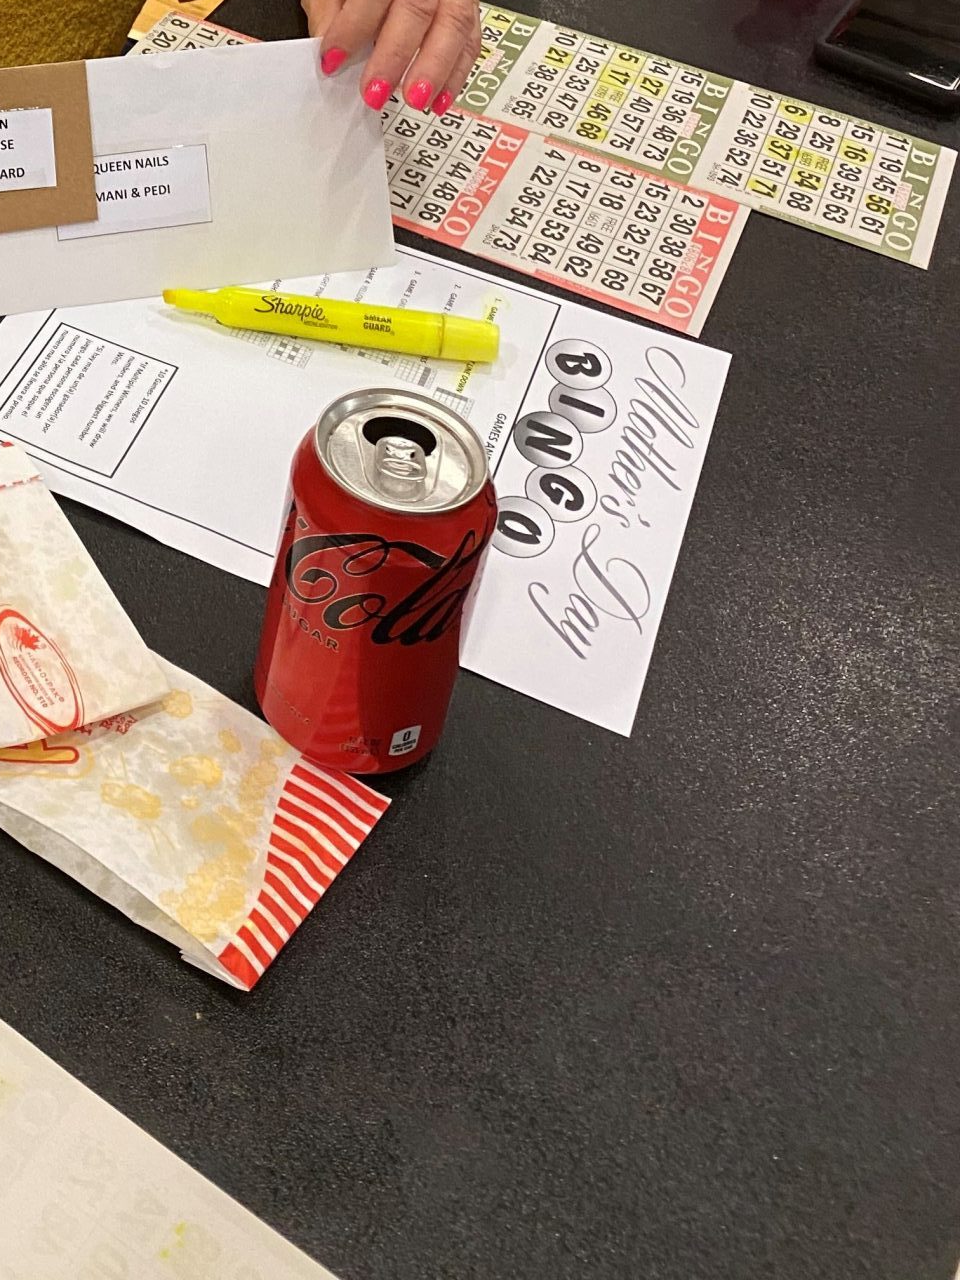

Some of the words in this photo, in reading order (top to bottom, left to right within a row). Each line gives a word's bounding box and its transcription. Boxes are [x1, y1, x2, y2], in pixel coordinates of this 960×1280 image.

[170, 18, 190, 30] 8
[491, 13, 511, 24] 4
[152, 31, 177, 49] 20
[196, 27, 219, 41] 11
[481, 26, 504, 43] 26
[555, 32, 578, 46] 10
[545, 47, 568, 63] 21
[587, 42, 608, 55] 11
[576, 57, 599, 74] 25
[619, 53, 639, 63] 5
[534, 65, 558, 81] 38
[609, 70, 630, 85] 17
[649, 61, 672, 76] 14
[565, 76, 589, 91] 33
[640, 78, 663, 96] 27
[681, 71, 704, 86] 15
[522, 82, 548, 99] 52
[672, 90, 695, 104] 19
[512, 100, 536, 118] 65
[556, 93, 578, 110] 47
[630, 97, 653, 113] 40
[750, 94, 774, 108] 10
[587, 103, 611, 121] 46
[662, 106, 686, 123] 36
[742, 110, 766, 128] 22
[785, 105, 807, 116] 6
[394, 118, 421, 138] 29
[440, 113, 464, 129] 15
[543, 112, 568, 128] 62
[621, 114, 644, 132] 57
[818, 115, 840, 127] 8
[472, 124, 496, 139] 14
[576, 122, 601, 139] 68
[652, 125, 677, 142] 48
[734, 129, 758, 147] 36
[776, 120, 800, 140] 29
[851, 125, 875, 142] 15
[426, 130, 452, 149] 26
[610, 134, 635, 151] 75
[809, 132, 834, 152] 25
[886, 136, 909, 152] 11
[413, 150, 440, 168] 34
[461, 141, 485, 161] 27
[545, 150, 566, 161] 4
[643, 144, 668, 161] 73
[725, 148, 750, 166] 52
[768, 140, 792, 160] 37
[844, 146, 868, 162] 16
[93, 160, 132, 175] QUEEN
[135, 156, 169, 169] NAILS
[446, 162, 471, 180] 44
[578, 161, 601, 172] 8
[760, 160, 786, 177] 51
[837, 164, 862, 181] 39
[879, 157, 903, 172] 19
[400, 169, 426, 188] 51
[530, 166, 557, 186] 22
[610, 171, 636, 188] 13
[717, 169, 742, 186] 74
[794, 171, 821, 190] 54
[872, 175, 897, 194] 45
[96, 189, 128, 203] MANI
[131, 188, 141, 198] &
[144, 184, 171, 197] PEDI
[432, 182, 458, 200] 48
[518, 187, 545, 206] 36
[566, 180, 591, 198] 17
[645, 183, 670, 200] 15
[752, 180, 777, 198] 71
[830, 183, 855, 202] 55
[390, 190, 414, 210] 71
[553, 199, 580, 219] 33
[599, 192, 626, 210] 18
[682, 195, 704, 208] 2
[787, 192, 813, 211] 68
[866, 195, 891, 214] 56
[418, 203, 446, 223] 66
[506, 208, 533, 228] 54
[634, 201, 661, 222] 23
[823, 204, 848, 223] 63
[540, 220, 570, 240] 53
[670, 214, 696, 235] 30
[859, 217, 884, 235] 61
[493, 230, 522, 250] 73
[623, 224, 650, 244] 32
[576, 233, 604, 254] 49
[660, 236, 686, 257] 38
[528, 243, 556, 264] 64
[613, 246, 640, 266] 51
[564, 256, 592, 277] 62
[648, 258, 676, 280] 58
[601, 270, 628, 290] 69
[639, 283, 666, 305] 67
[253, 295, 326, 322] Sharpie
[363, 322, 391, 333] GUARD
[109, 379, 120, 390] and
[103, 389, 114, 400] the
[90, 399, 107, 419] biggest
[77, 419, 95, 441] number
[488, 413, 507, 442] GAMES
[88, 433, 102, 448] draw
[600, 346, 700, 529] Mother's
[527, 523, 651, 660] Day
